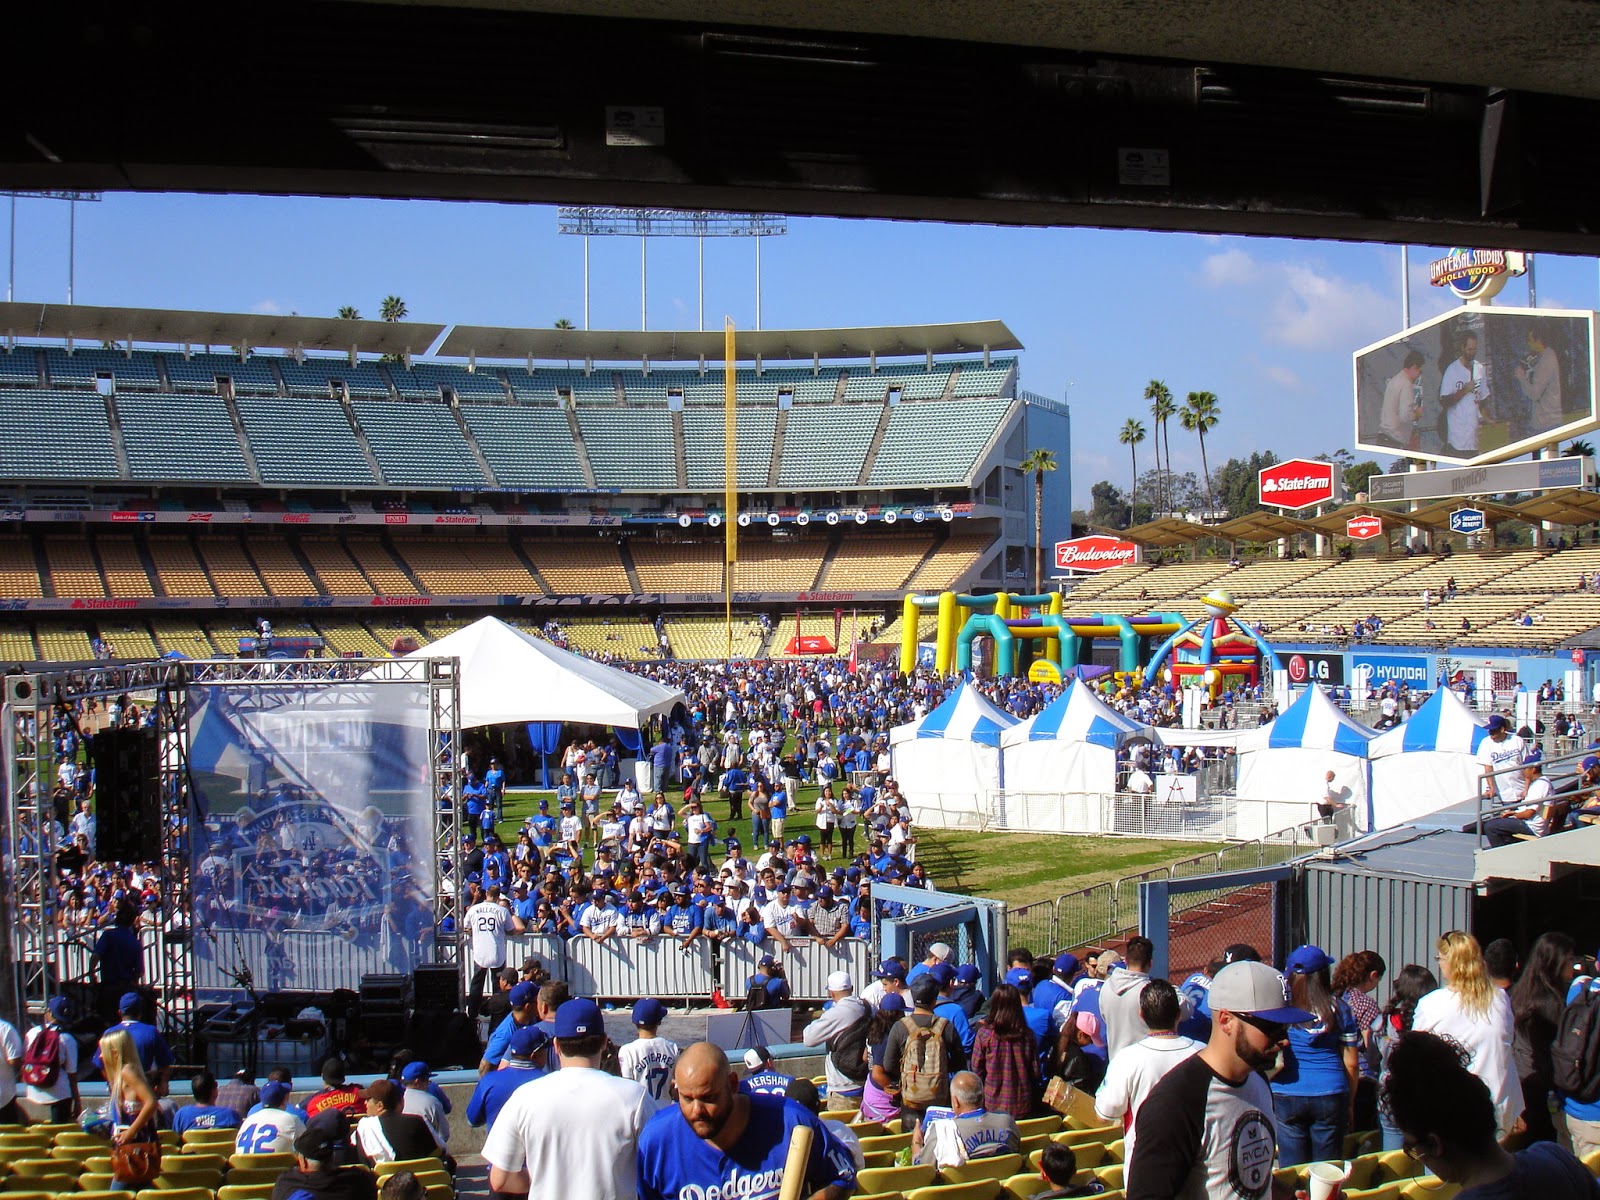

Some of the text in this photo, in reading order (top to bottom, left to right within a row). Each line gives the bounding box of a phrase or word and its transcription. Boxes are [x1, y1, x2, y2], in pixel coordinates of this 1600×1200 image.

[1430, 249, 1504, 279] UNIVERSAL STUDIOS
[1440, 266, 1495, 284] HOLLYWOOD
[1277, 475, 1330, 491] StateFarm
[1058, 545, 1134, 563] Budweiser
[86, 598, 137, 609] StateFarm
[384, 596, 431, 606] StateFarm
[810, 591, 854, 600] StateFarm
[1376, 665, 1426, 681] HYUNDAI
[478, 916, 496, 932] 29
[645, 1067, 669, 1101] 17
[747, 1075, 790, 1089] KERSHAW
[316, 1093, 356, 1113] KERSHAW
[196, 1114, 216, 1127] PUIG
[237, 1123, 279, 1154] 42
[964, 1129, 1013, 1153] ONZALEZ
[1242, 1144, 1270, 1164] RVCA
[678, 1168, 785, 1200] Dodgers
